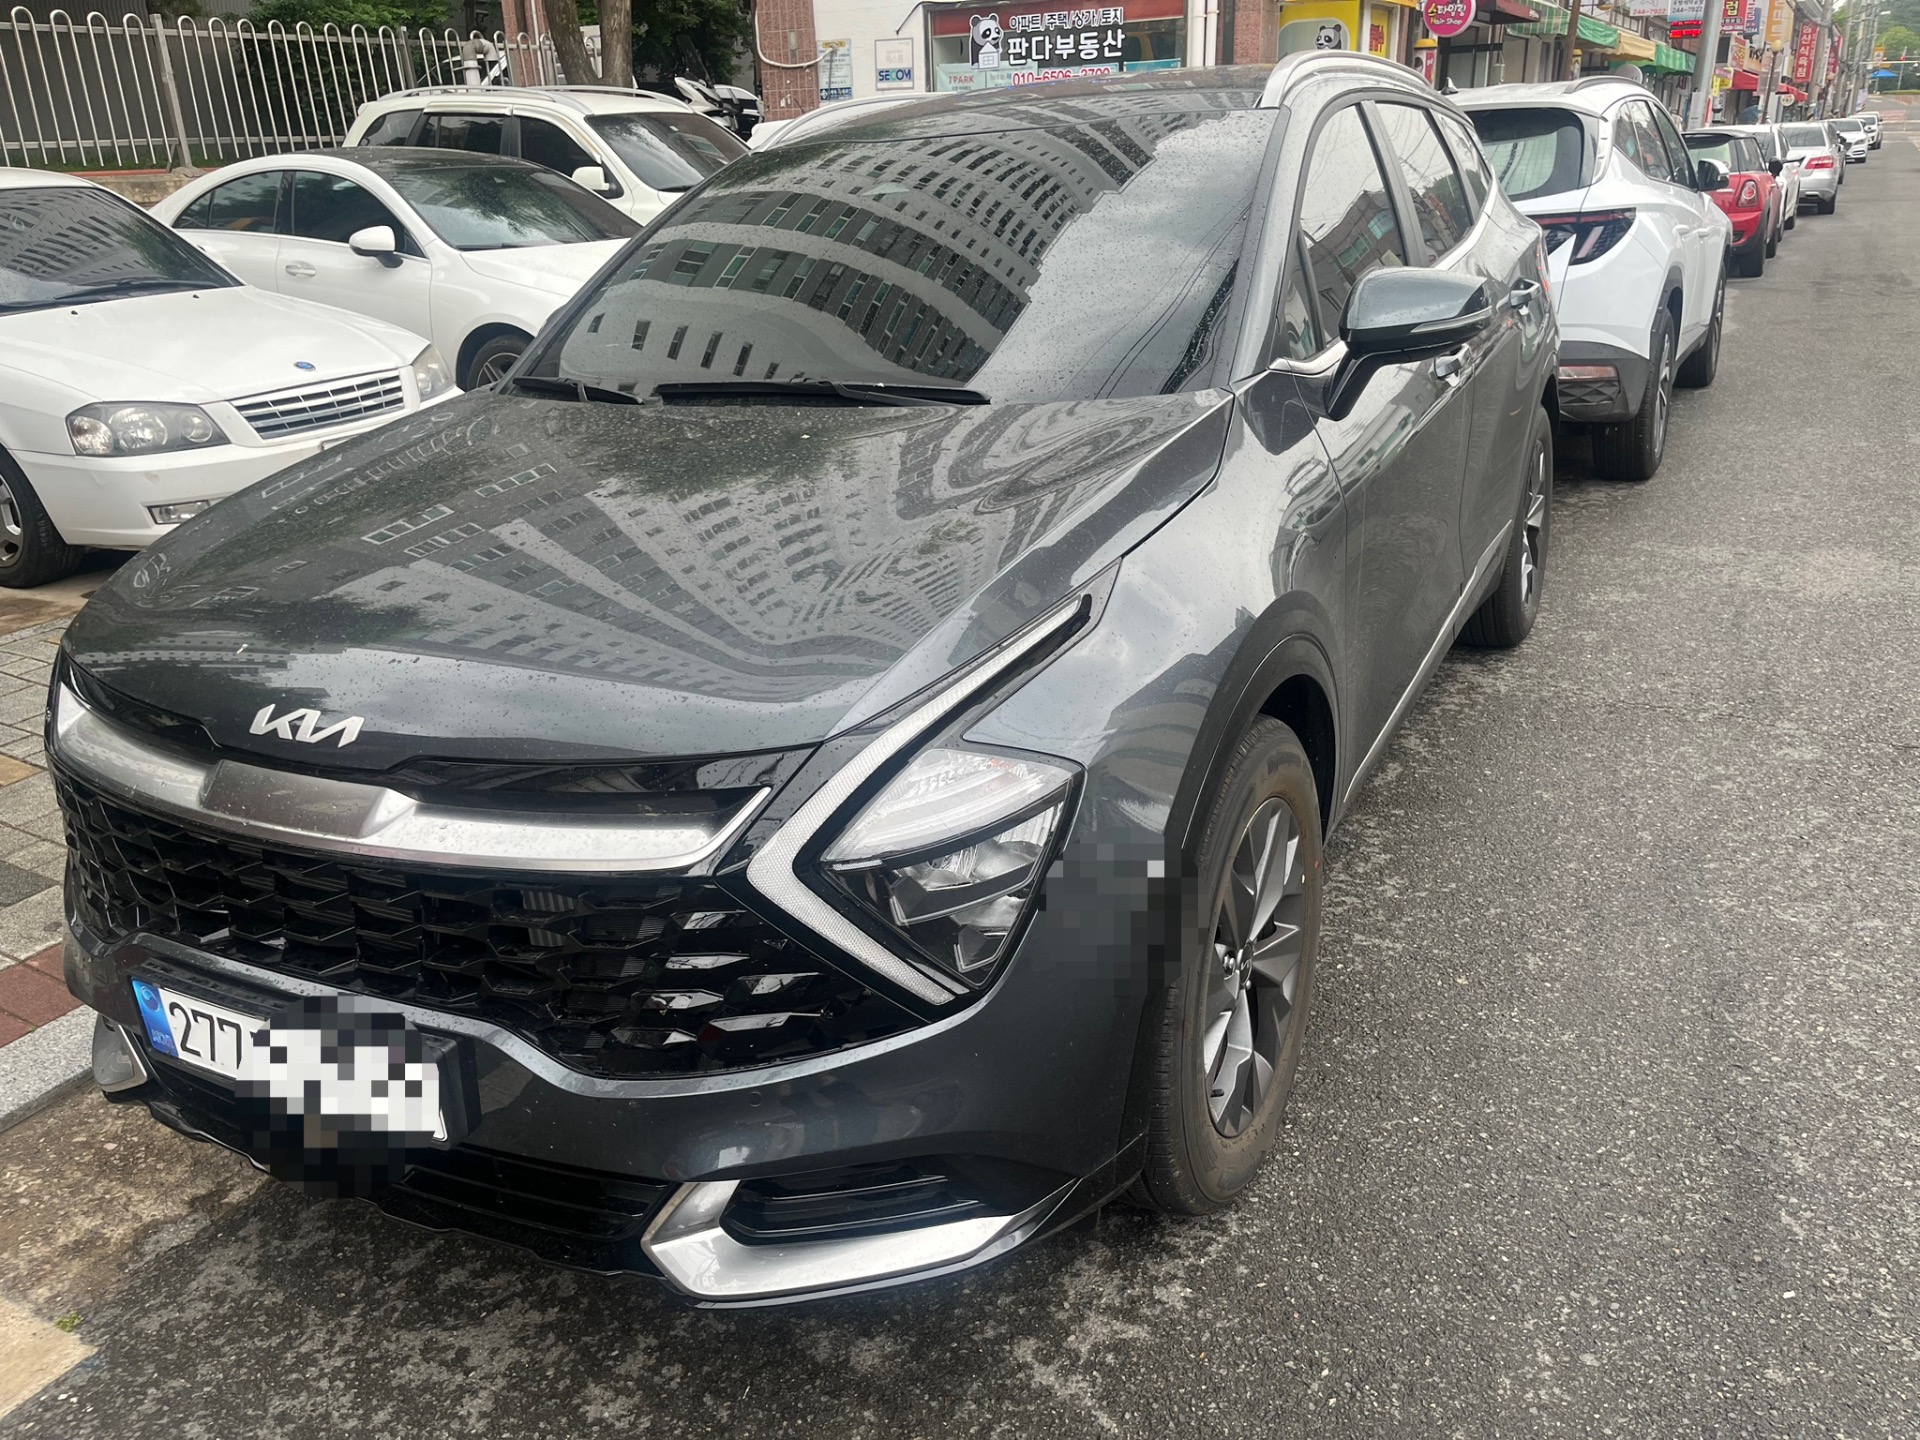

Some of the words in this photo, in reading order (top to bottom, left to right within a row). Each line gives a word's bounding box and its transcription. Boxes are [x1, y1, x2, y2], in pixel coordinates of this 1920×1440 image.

[1009, 7, 1124, 32] 아파트/주택/상가/토지
[1427, 2, 1467, 17] 스타일링
[1431, 17, 1445, 25] Hair
[1446, 17, 1463, 26] Shop
[1007, 28, 1126, 65] 판다부동산
[878, 69, 911, 81] SECOM
[249, 703, 365, 748] KIA
